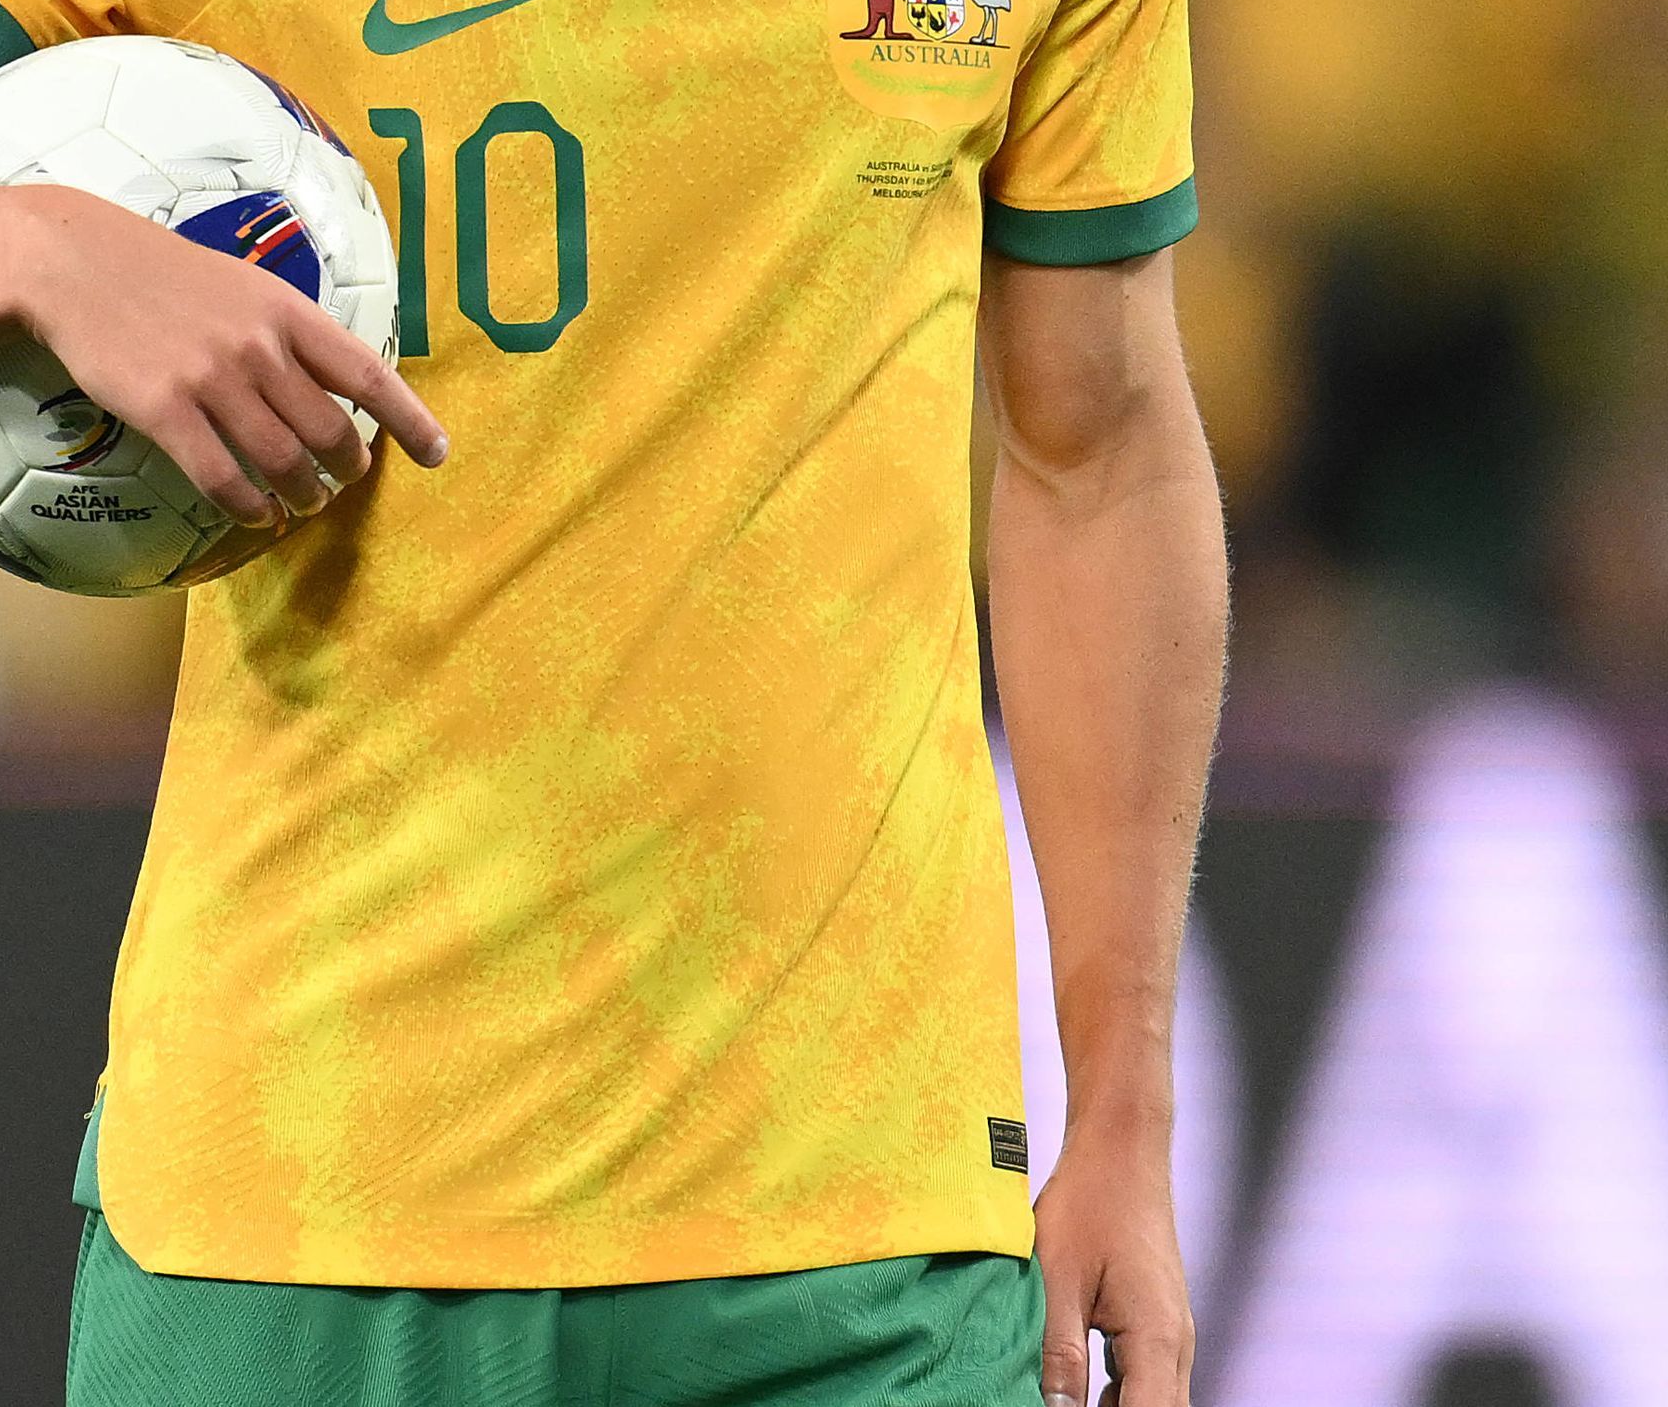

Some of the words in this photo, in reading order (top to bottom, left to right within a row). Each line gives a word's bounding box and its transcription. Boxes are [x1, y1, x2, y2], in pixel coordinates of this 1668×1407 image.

[870, 44, 991, 69] AUSTRALIA
[866, 161, 920, 172] AUSTRALIA
[856, 174, 910, 185] THURSDAY
[368, 101, 589, 357] 10
[72, 485, 99, 494] AFC
[54, 494, 120, 508] ASIAN
[31, 504, 152, 522] QUALIFIERS
